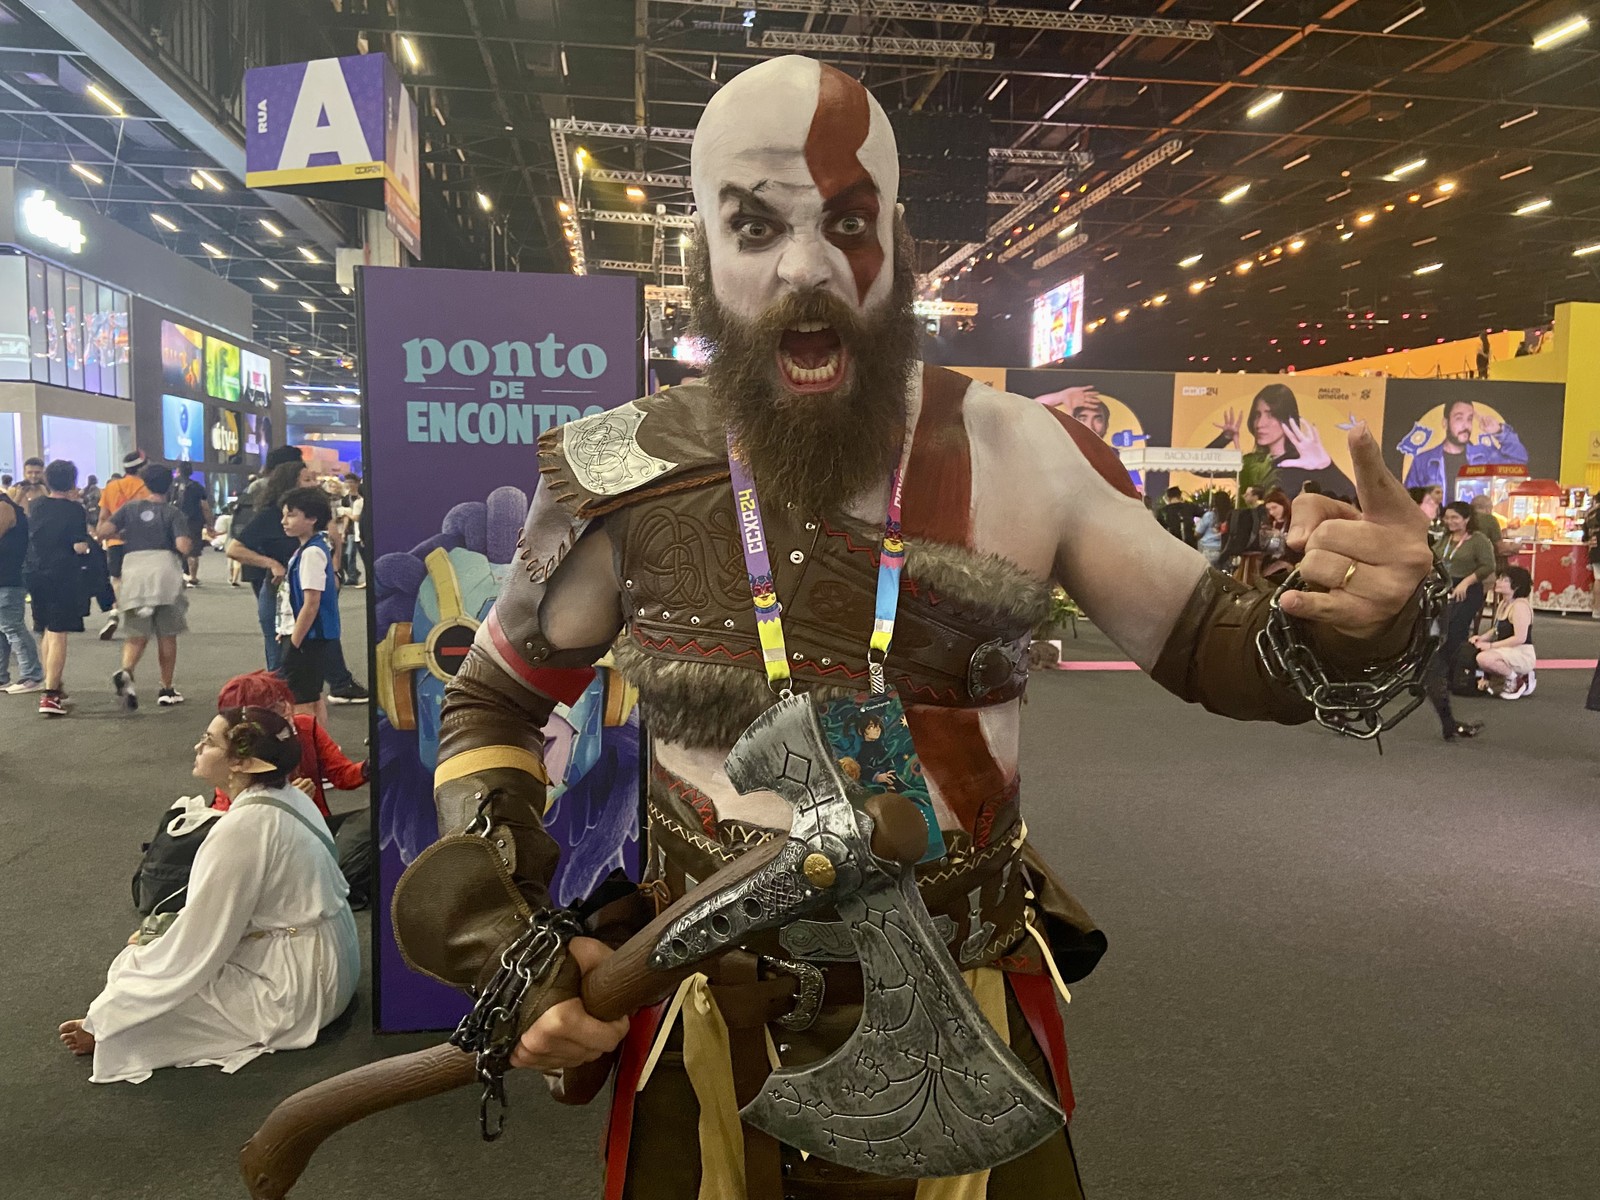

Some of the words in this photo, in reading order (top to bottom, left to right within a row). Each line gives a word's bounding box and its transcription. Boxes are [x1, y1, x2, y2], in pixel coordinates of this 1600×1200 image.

[257, 99, 268, 134] RUA
[277, 57, 373, 170] A
[401, 332, 608, 383] ponto
[489, 381, 525, 400] DE
[406, 401, 606, 445] ENCONT
[738, 488, 763, 554] CCXP24
